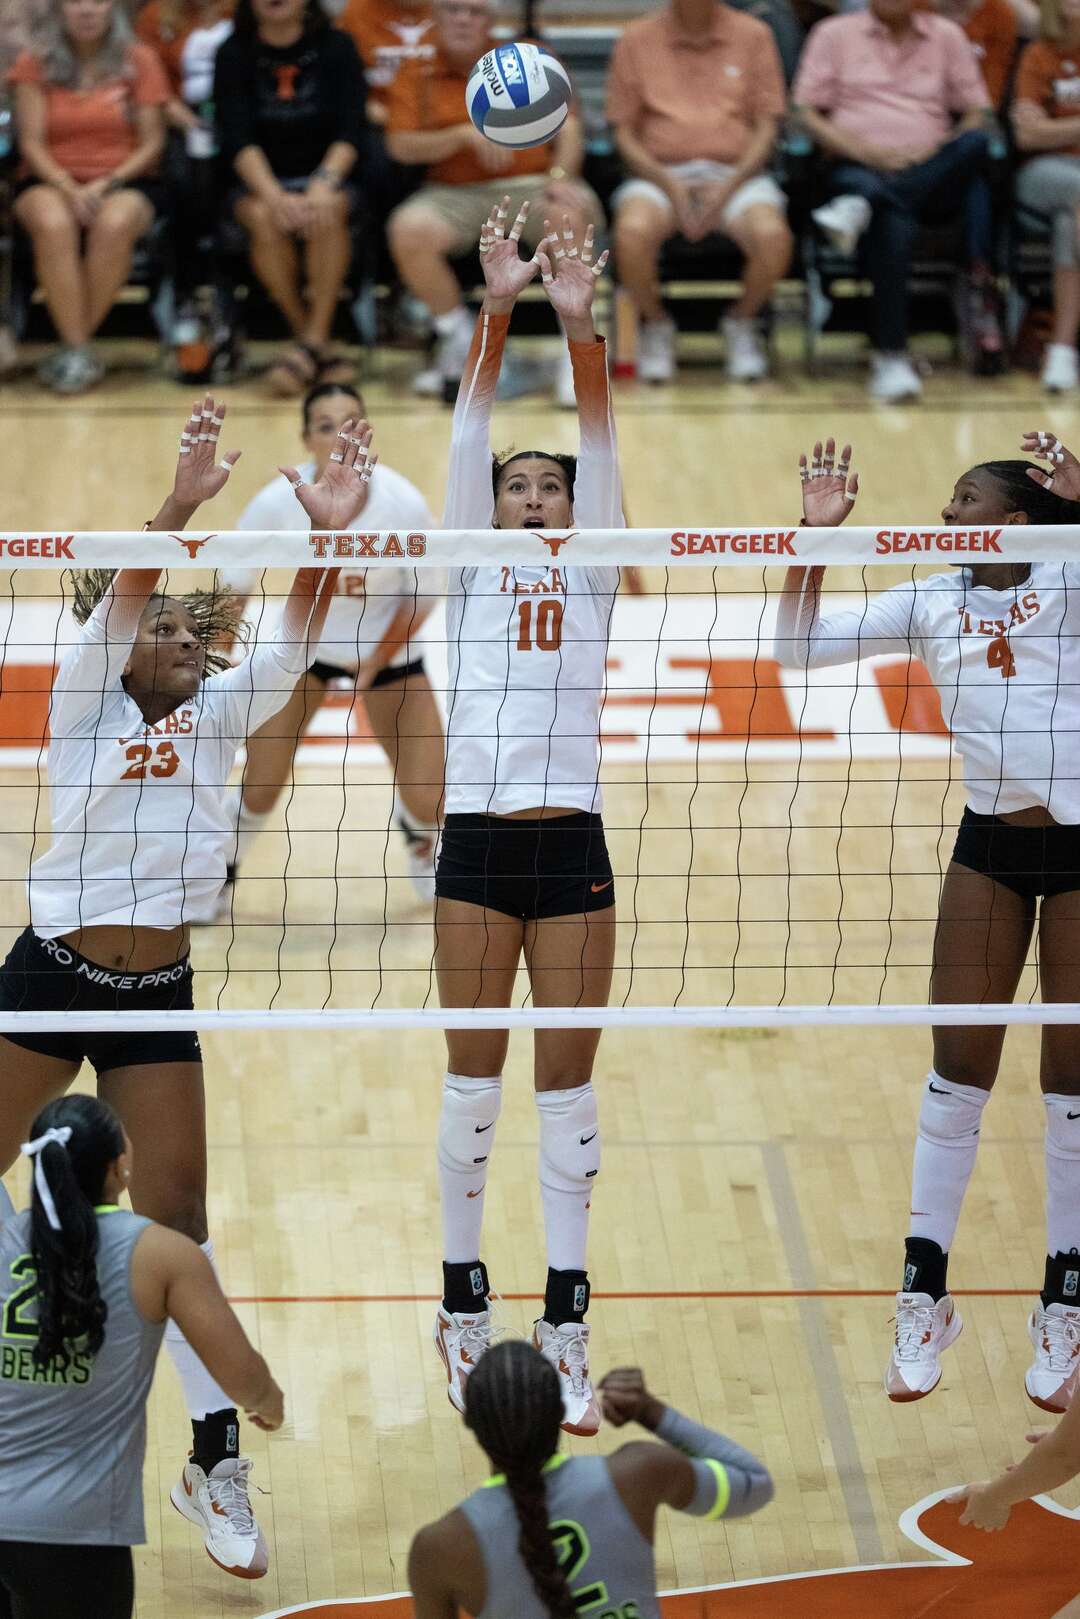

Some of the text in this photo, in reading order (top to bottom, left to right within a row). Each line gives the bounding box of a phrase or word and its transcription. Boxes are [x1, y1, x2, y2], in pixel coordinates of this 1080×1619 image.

[309, 533, 427, 558] TEXAS
[671, 531, 797, 556] SEATGEEK
[876, 528, 1003, 555] SEATGEEK
[517, 599, 563, 651] 10
[986, 635, 1017, 678] 4
[119, 741, 181, 779] 23
[40, 938, 183, 989] RO NIKE PRO
